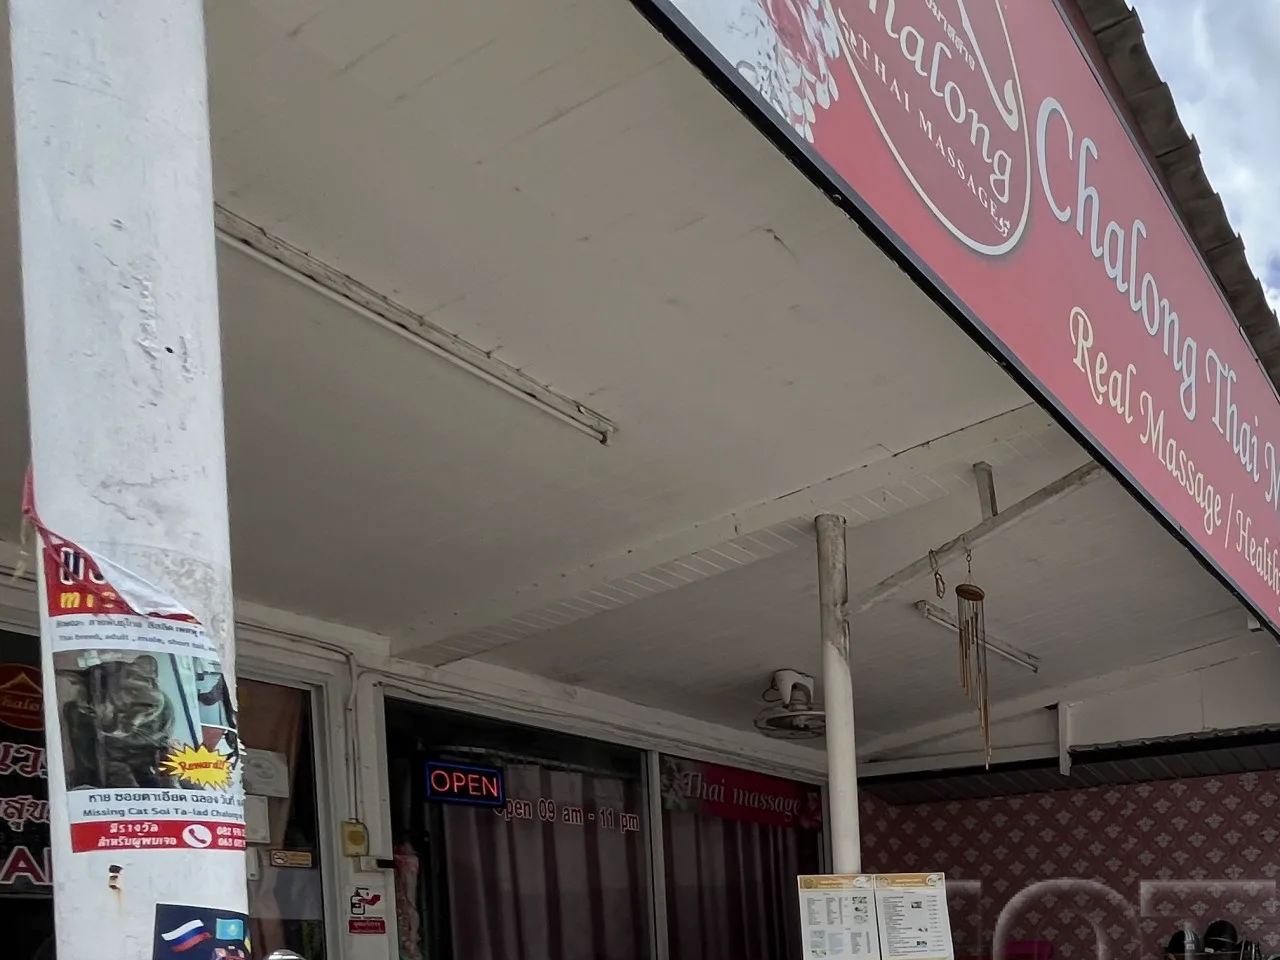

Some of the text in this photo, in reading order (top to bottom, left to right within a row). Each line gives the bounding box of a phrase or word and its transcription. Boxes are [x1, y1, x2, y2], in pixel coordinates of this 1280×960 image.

[857, 32, 1000, 222] THAI MASSAGE
[1035, 96, 1198, 421] Chalong
[1205, 347, 1260, 483] Thai
[1069, 305, 1137, 425] Real
[1138, 390, 1222, 536] Massage
[430, 769, 499, 797] OPEN
[682, 769, 800, 821] Thai massage
[82, 808, 125, 817] Missing
[128, 808, 149, 816] Cat
[151, 807, 171, 815] Soi
[538, 797, 557, 822] 09
[562, 805, 584, 825] am
[599, 807, 614, 829] 11
[619, 812, 640, 833] pm
